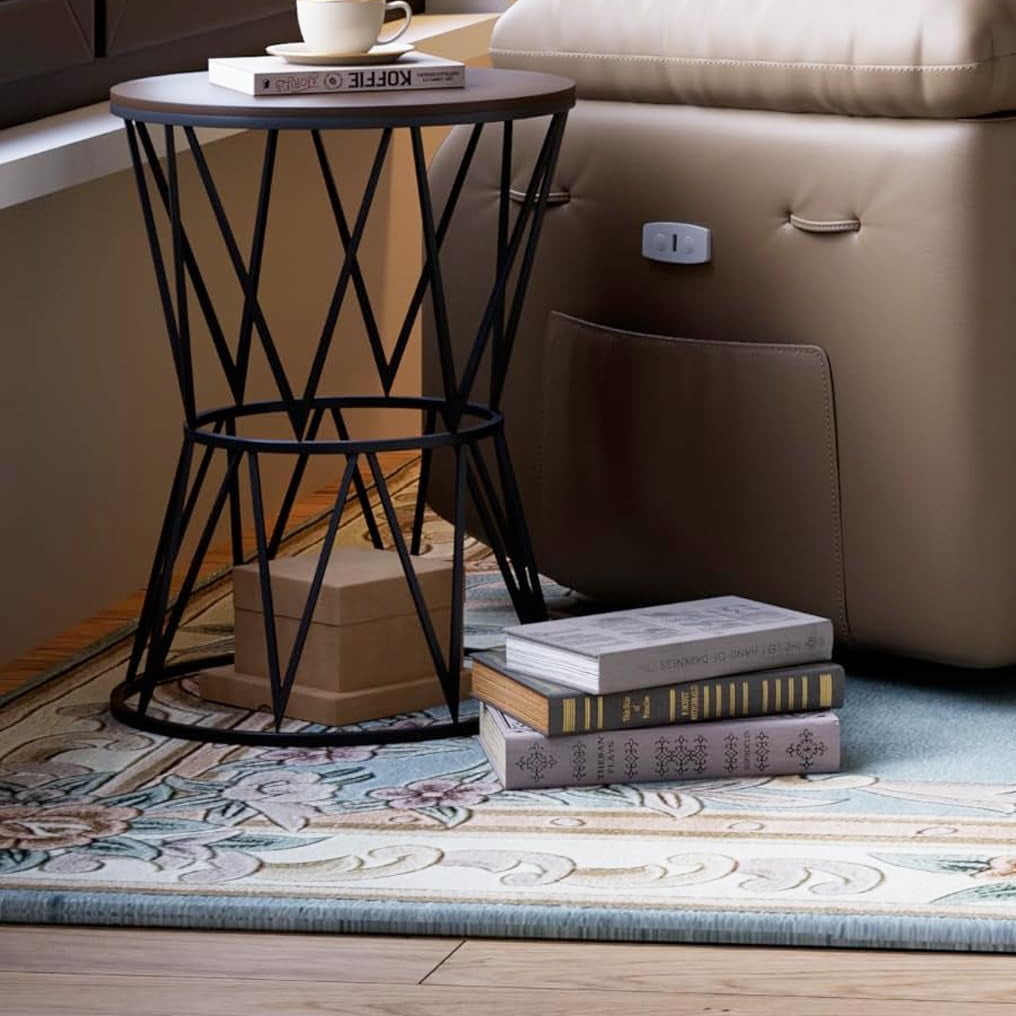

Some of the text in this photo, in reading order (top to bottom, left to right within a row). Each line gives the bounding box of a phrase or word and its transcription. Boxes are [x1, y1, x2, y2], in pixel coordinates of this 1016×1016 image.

[348, 70, 412, 89] KOFFIE
[659, 653, 710, 668] DARKNESS
[712, 652, 727, 664] OF
[731, 646, 759, 659] HAND
[596, 735, 606, 781] THEBAN
[606, 740, 615, 774] PLAYS
